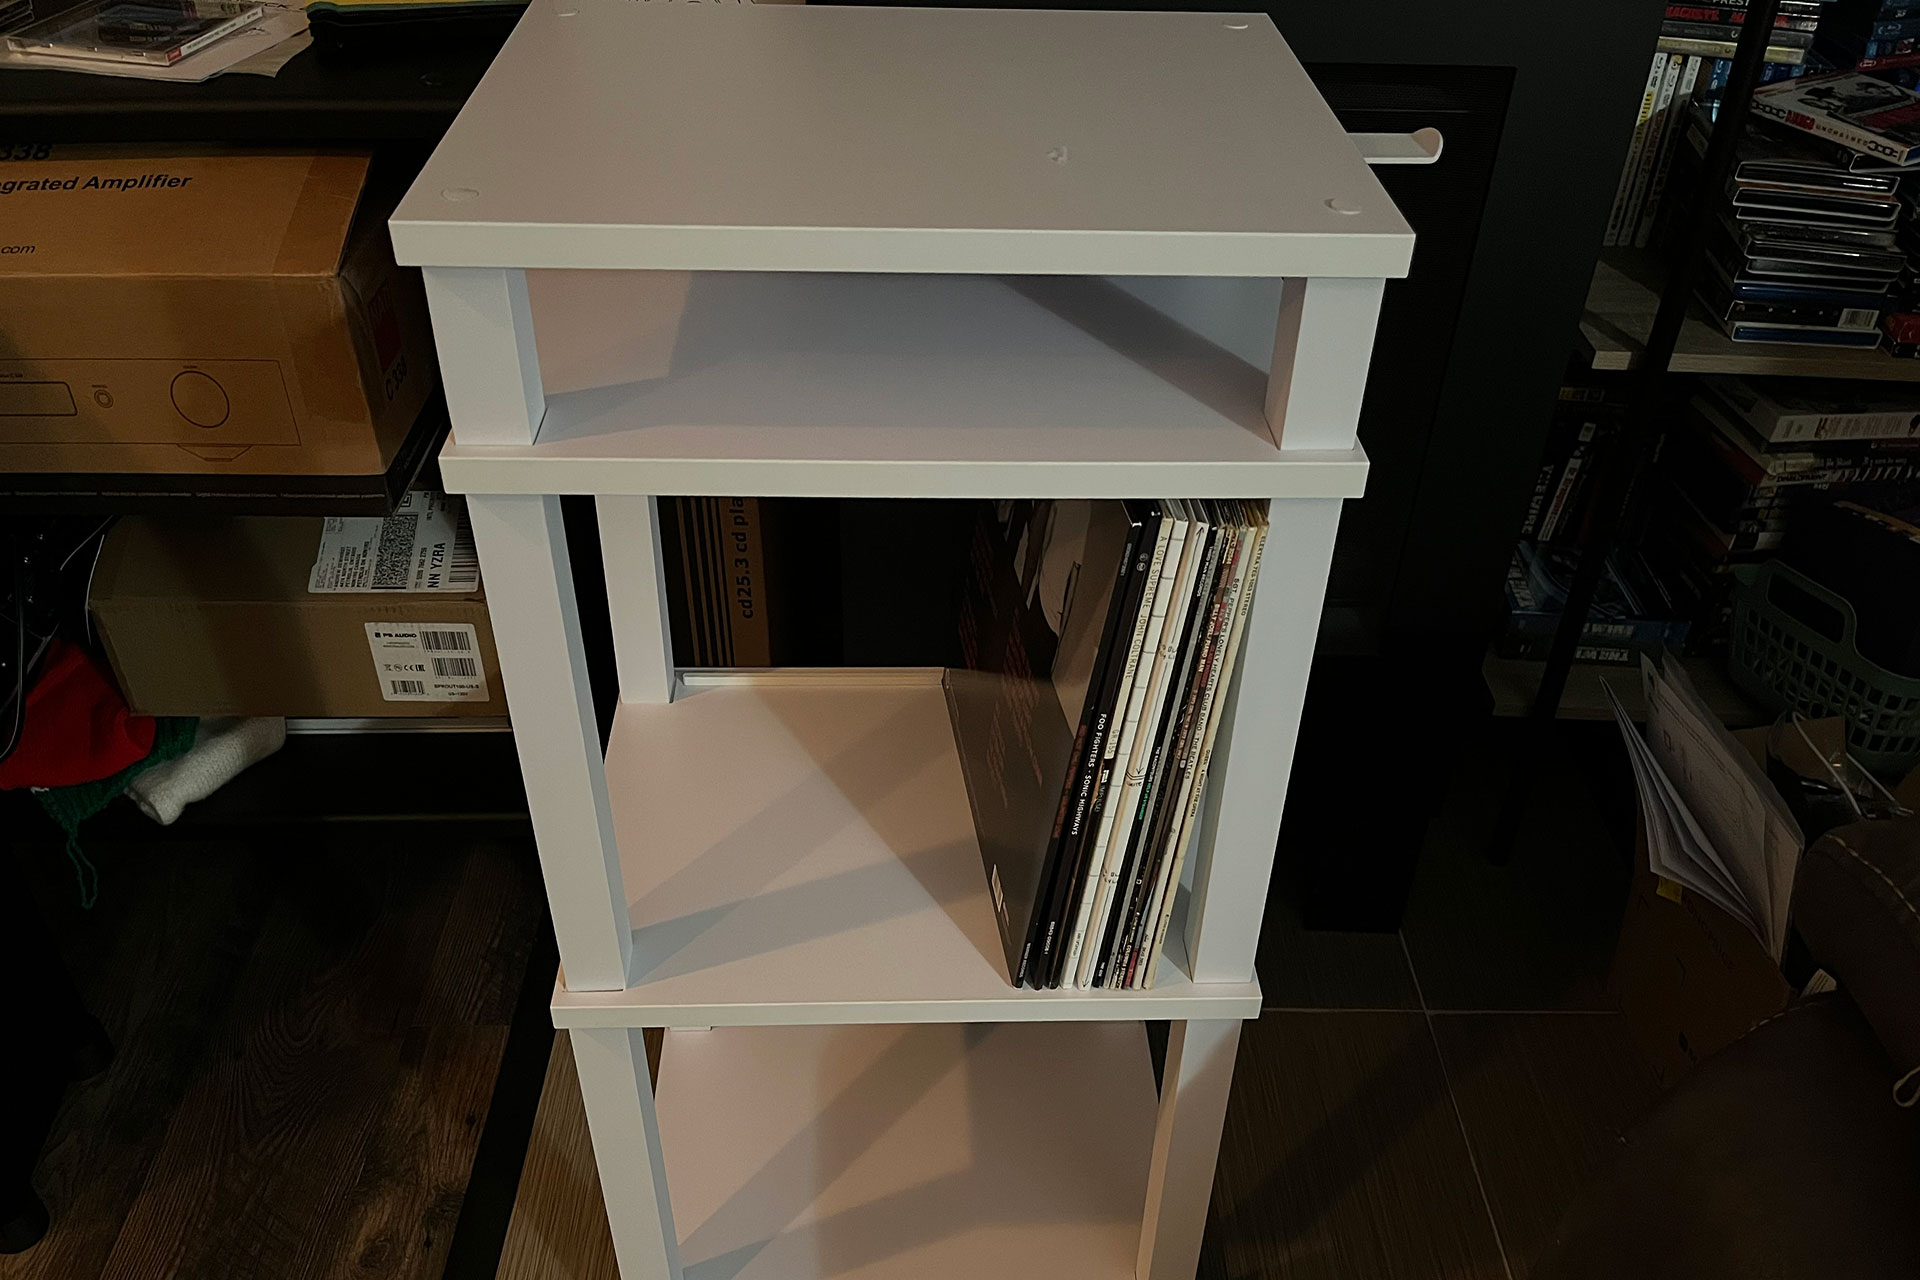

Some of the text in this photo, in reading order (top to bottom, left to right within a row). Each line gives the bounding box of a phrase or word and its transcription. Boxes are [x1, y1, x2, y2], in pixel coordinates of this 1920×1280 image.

[0, 174, 192, 194] grated Amplifier
[731, 532, 748, 553] cd
[1153, 543, 1164, 567] LOVE
[427, 542, 446, 588] NN YZRA
[735, 558, 754, 619] cd25.3
[1143, 569, 1157, 609] SUPREME
[1135, 613, 1146, 637] JOHN
[1222, 597, 1234, 632] PEPPER'S
[1125, 637, 1140, 679] COLTRANE
[1214, 634, 1224, 662] LONELY
[1207, 663, 1217, 691] HEARTS
[1201, 692, 1211, 711] CLUB
[1097, 712, 1106, 730] FOO
[1196, 711, 1206, 731] BAND
[1088, 731, 1101, 768] FIGHTERS
[1191, 737, 1199, 750] THE
[1184, 750, 1195, 780] BEATLES
[1081, 773, 1090, 797] SONIC
[1071, 797, 1085, 836] HIGHWAYS
